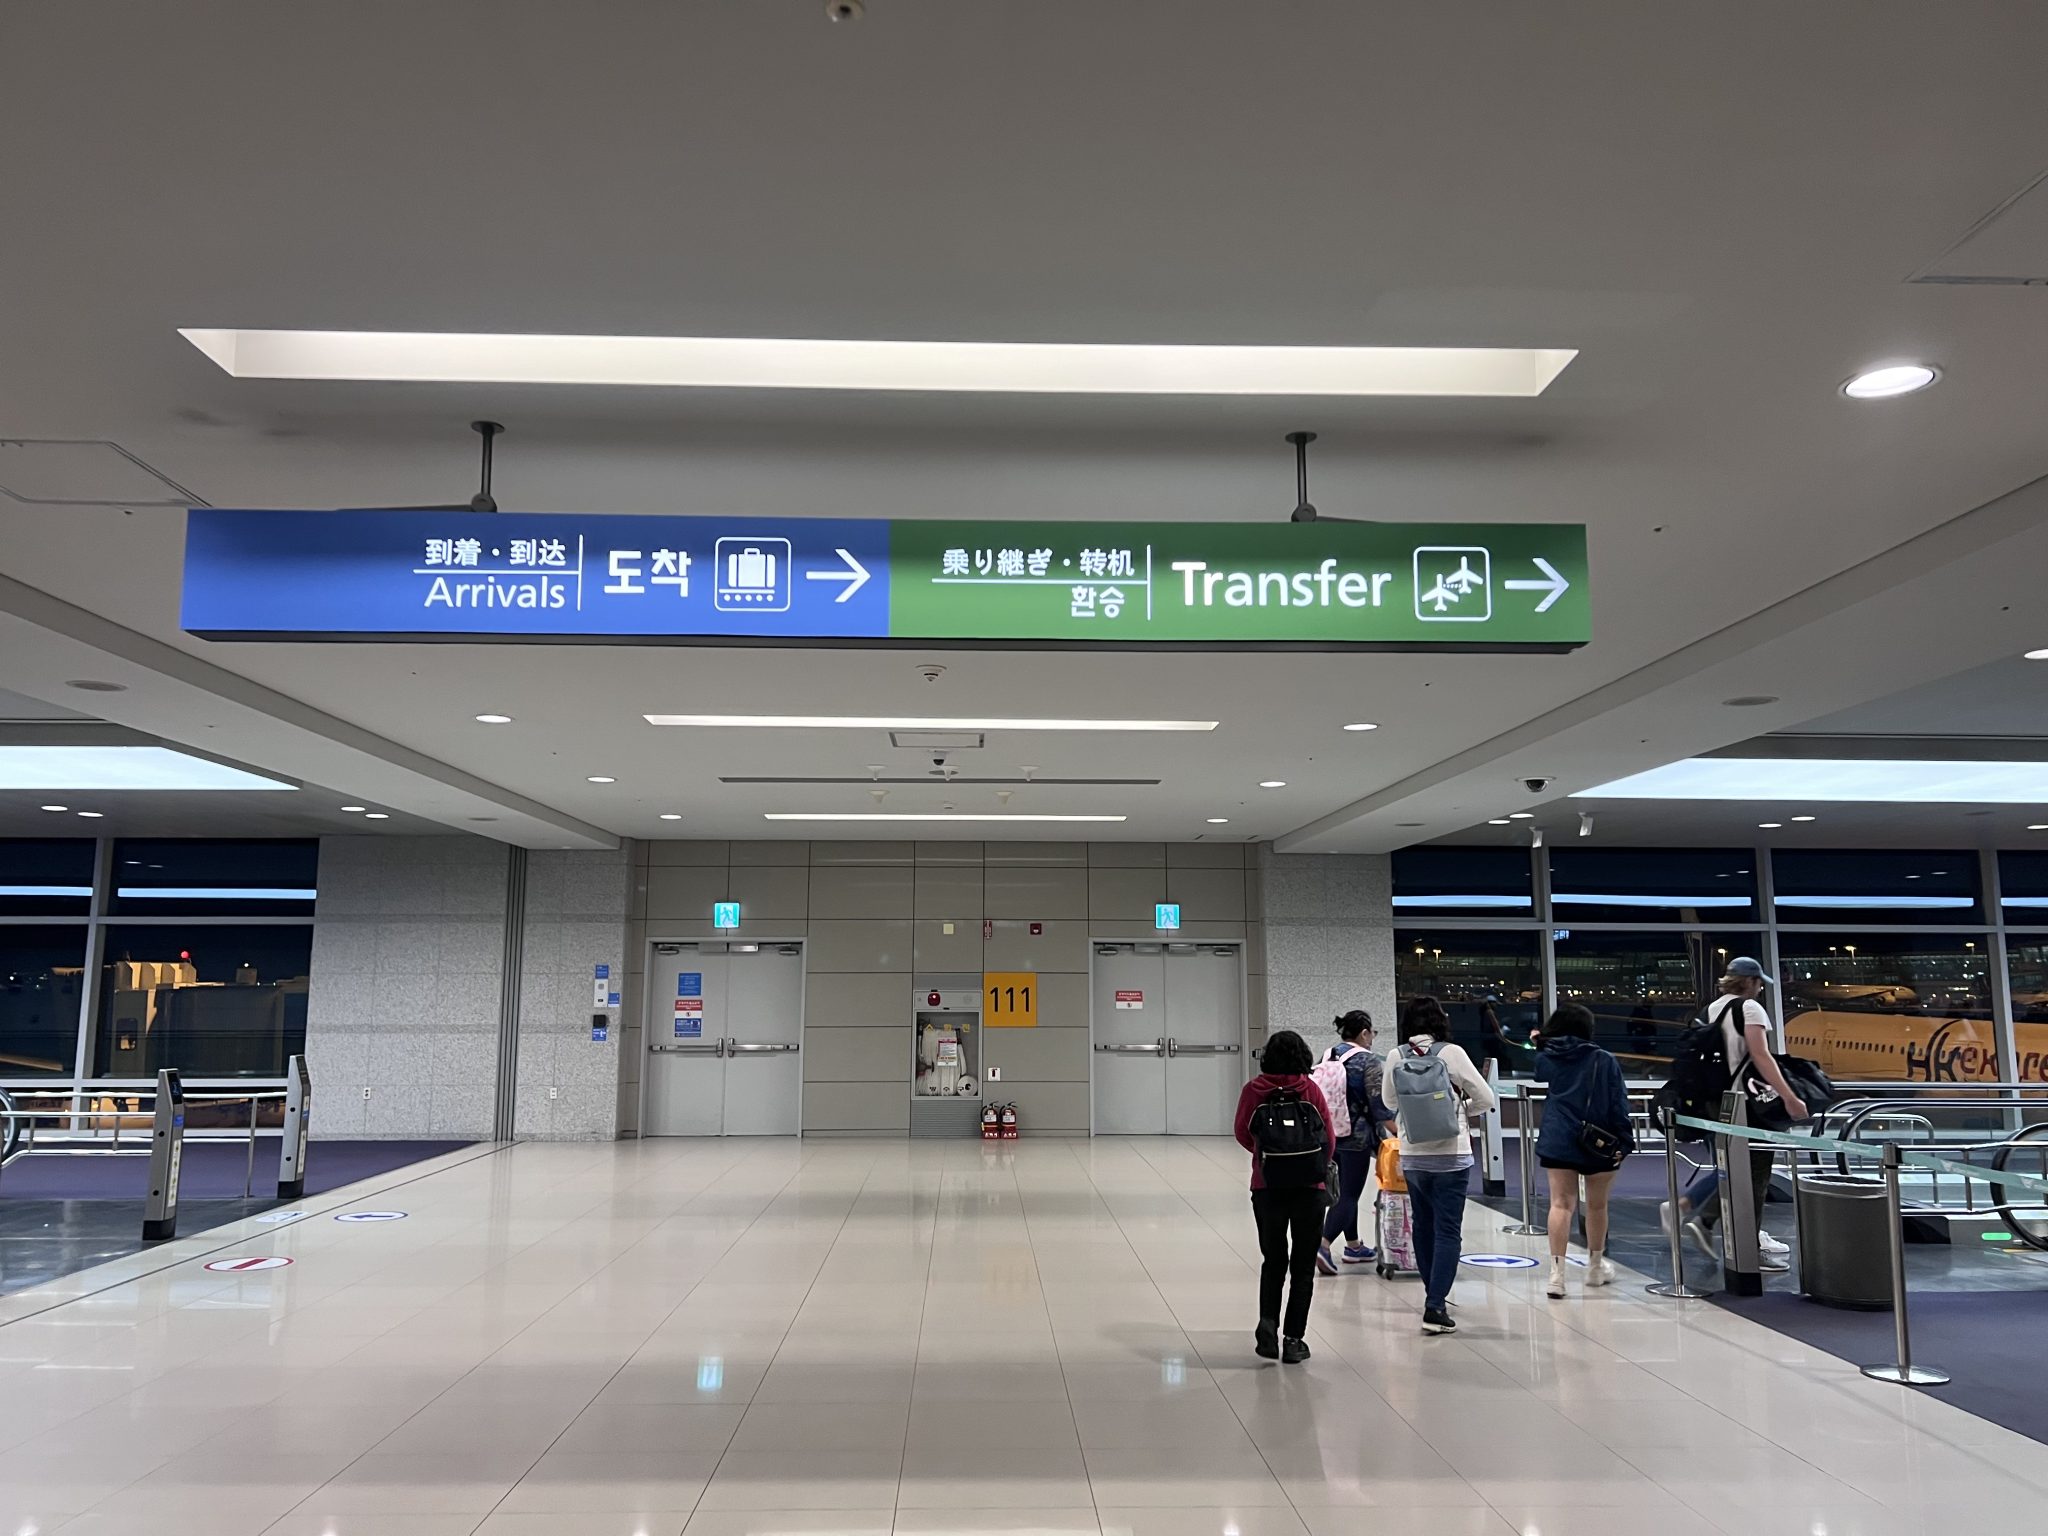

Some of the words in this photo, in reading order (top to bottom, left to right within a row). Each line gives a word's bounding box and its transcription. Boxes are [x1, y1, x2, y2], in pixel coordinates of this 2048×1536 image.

[603, 548, 692, 598] 도착
[1171, 558, 1392, 607] Transfer
[423, 575, 566, 609] Arrivals
[1071, 585, 1125, 619] 환승
[989, 986, 1031, 1013] 111
